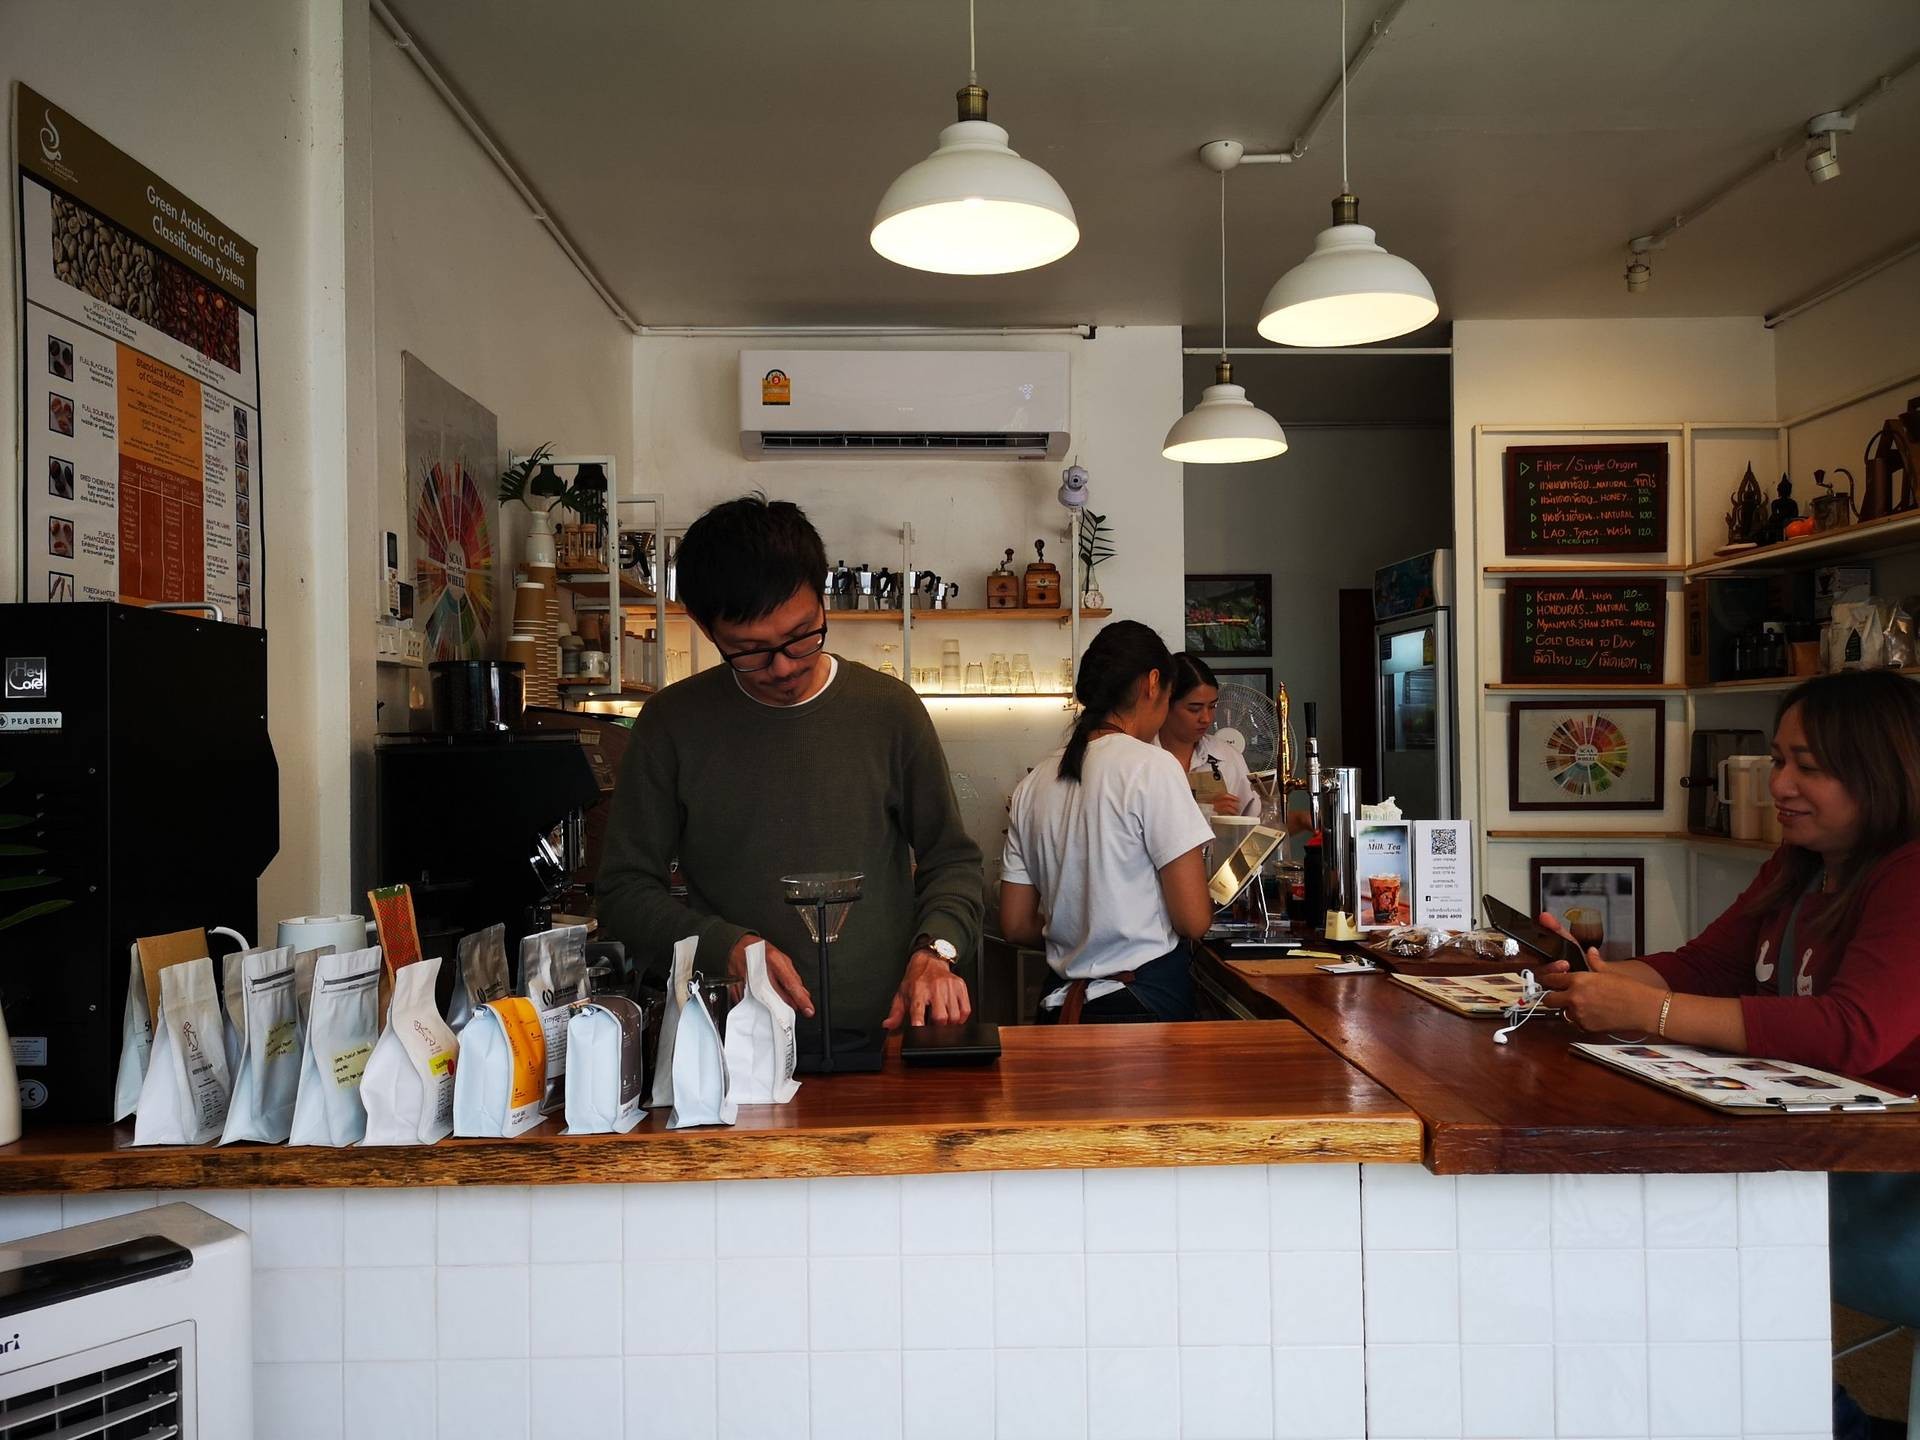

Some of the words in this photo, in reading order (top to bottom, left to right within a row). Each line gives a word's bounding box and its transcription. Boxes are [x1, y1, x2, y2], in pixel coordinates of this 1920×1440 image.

[146, 185, 178, 221] Green
[180, 208, 216, 247] Arabica
[217, 235, 245, 267] Coffee
[152, 216, 214, 268] Classification
[216, 257, 245, 291] System
[1536, 458, 1563, 473] Filter
[1575, 459, 1606, 474] Single
[1607, 458, 1639, 473] Origin
[1600, 493, 1627, 503] HONEY
[1536, 590, 1565, 603] KENYA
[1536, 603, 1585, 617] HONDURAS
[1535, 634, 1562, 647] COLD
[1565, 635, 1594, 647] BREW
[1367, 843, 1384, 851] Milk
[1387, 843, 1401, 851] Tea
